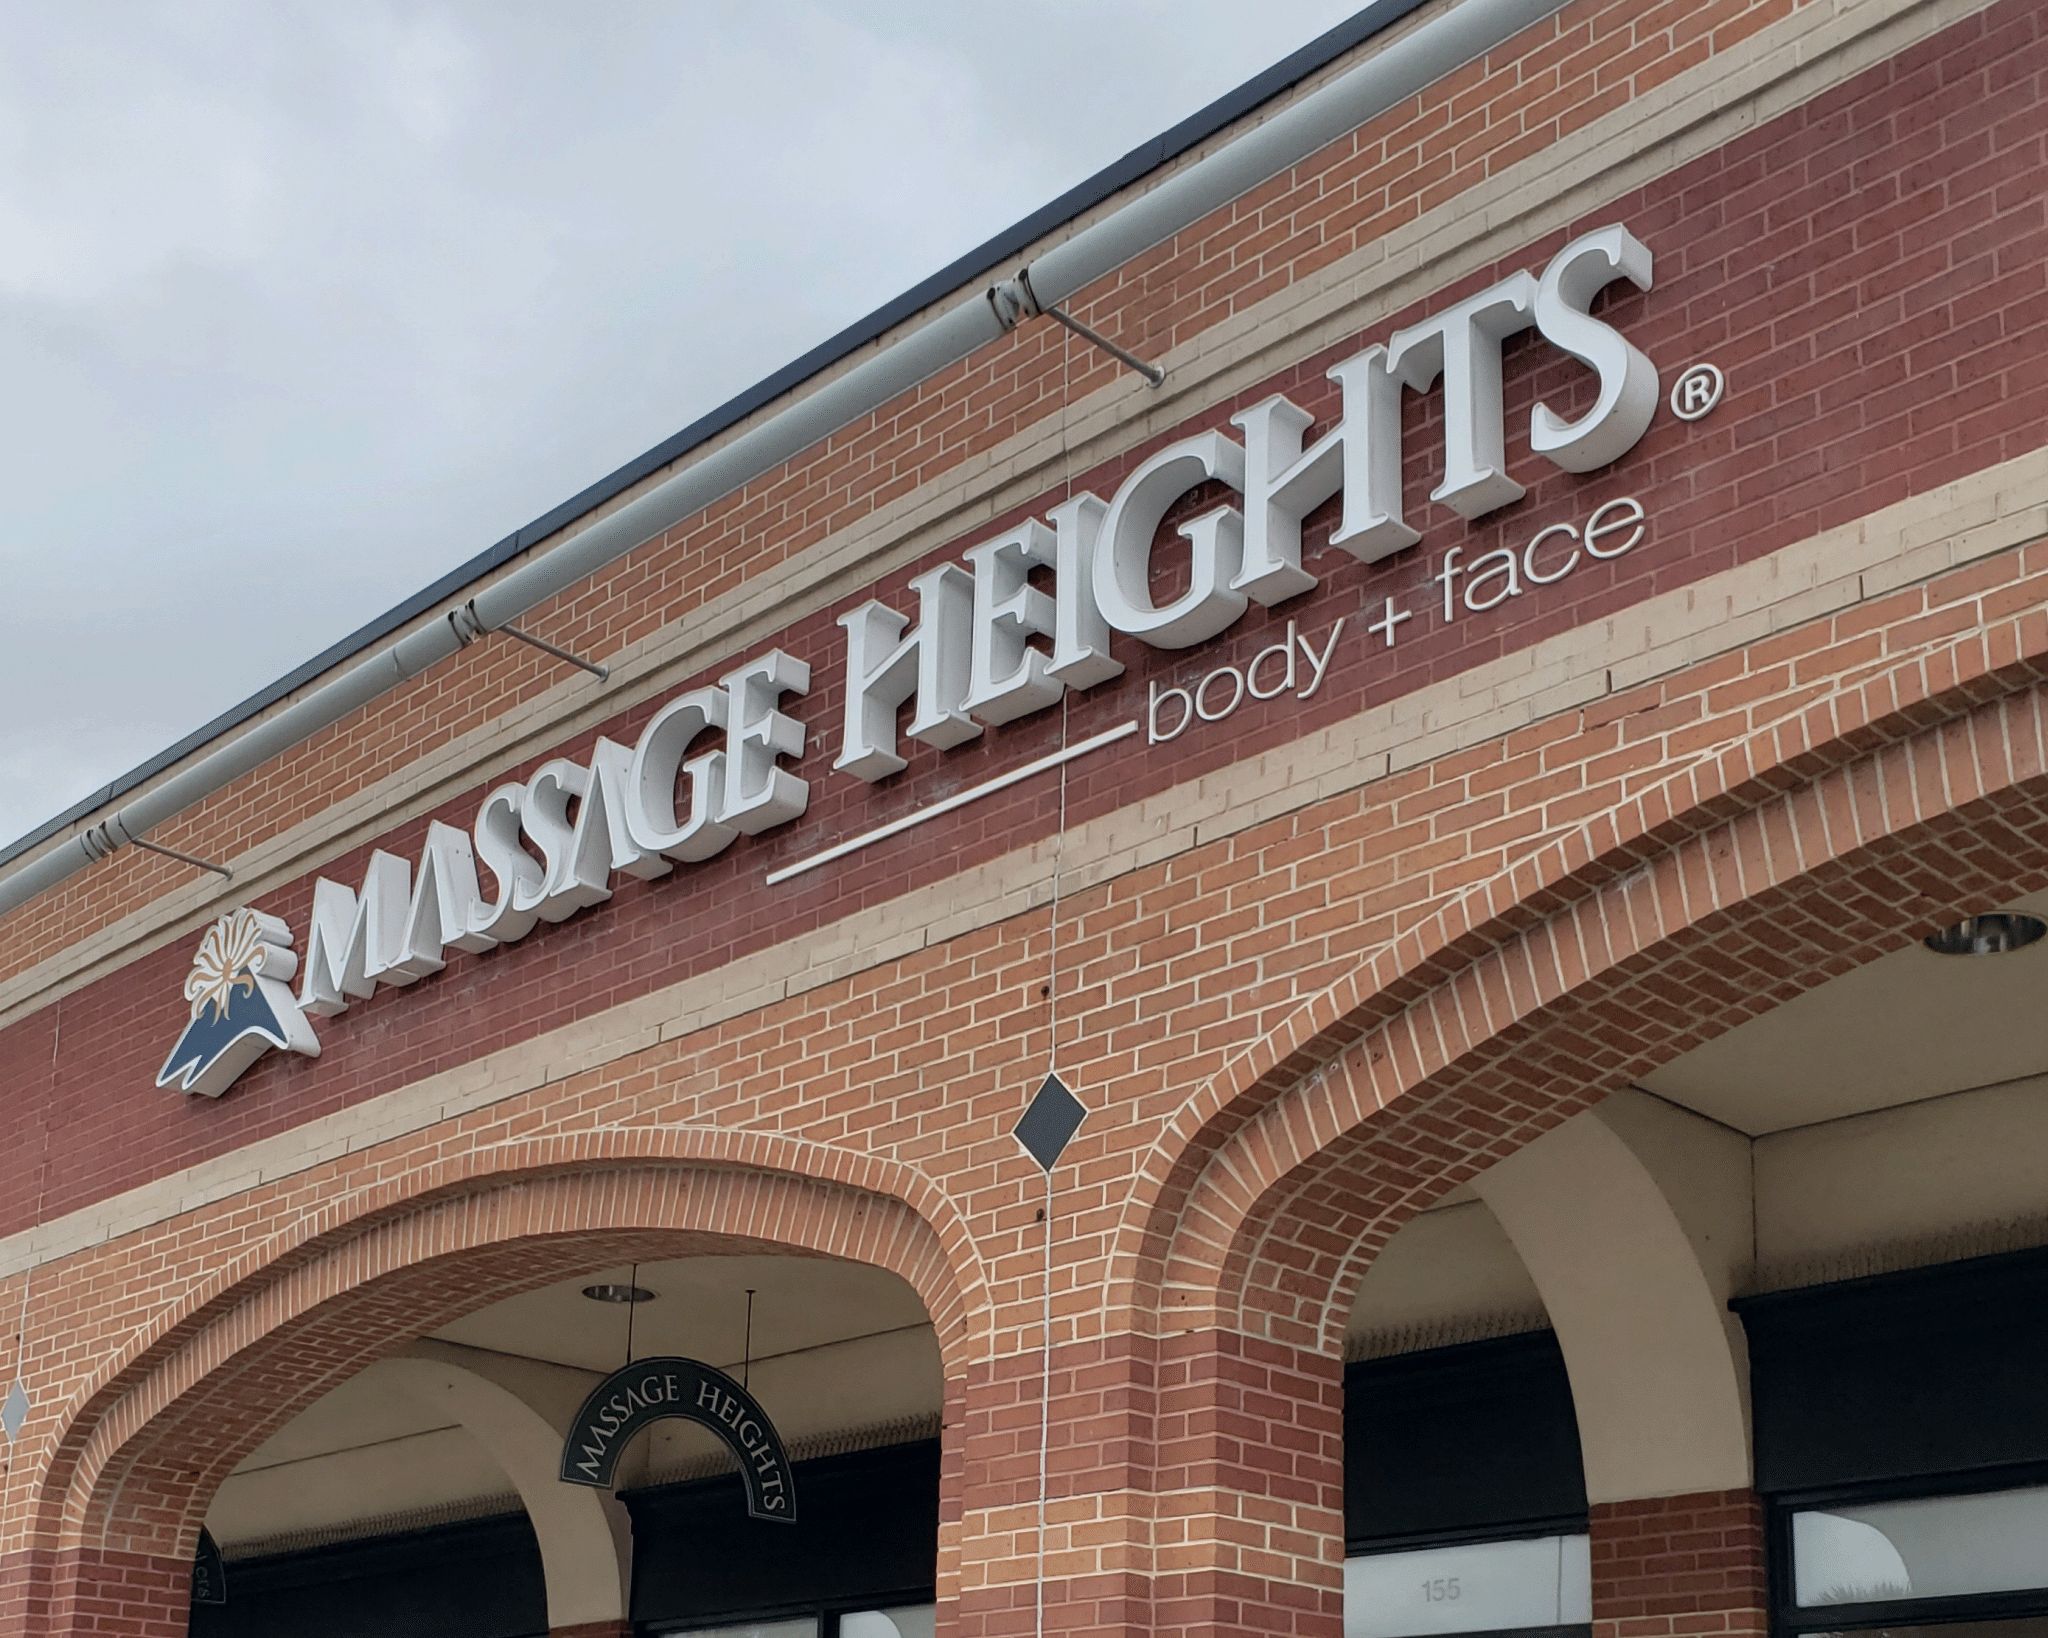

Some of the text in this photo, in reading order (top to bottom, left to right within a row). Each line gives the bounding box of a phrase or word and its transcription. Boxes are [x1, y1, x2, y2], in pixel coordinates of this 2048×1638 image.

[296, 648, 810, 1016] MASSAGE
[833, 222, 1658, 783] HEIGHTS
[1147, 616, 1345, 745] body
[1436, 496, 1645, 623] face
[576, 1375, 785, 1512] MASSAGE HEIGHTS
[1422, 1577, 1461, 1602] 155
